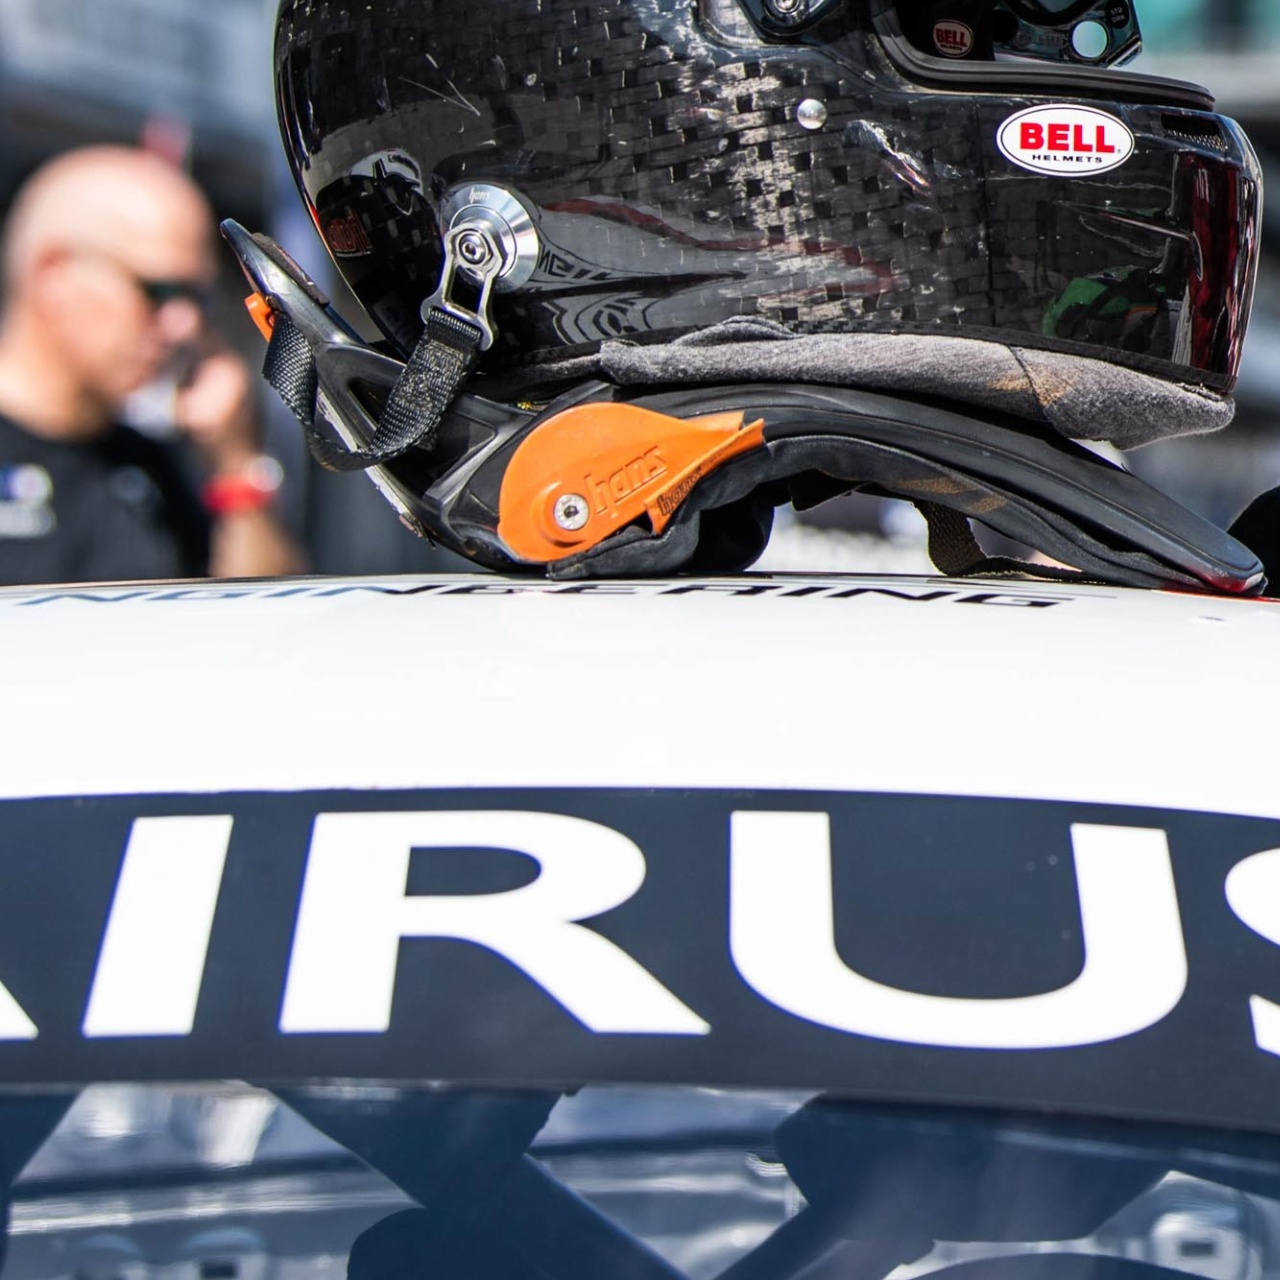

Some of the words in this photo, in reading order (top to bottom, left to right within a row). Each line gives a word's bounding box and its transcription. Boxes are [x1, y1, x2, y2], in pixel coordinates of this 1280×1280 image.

[935, 28, 968, 47] BELL
[1019, 121, 1116, 154] BELL
[1031, 154, 1103, 164] HELMETS
[469, 187, 490, 204] hans
[584, 444, 668, 518] hans
